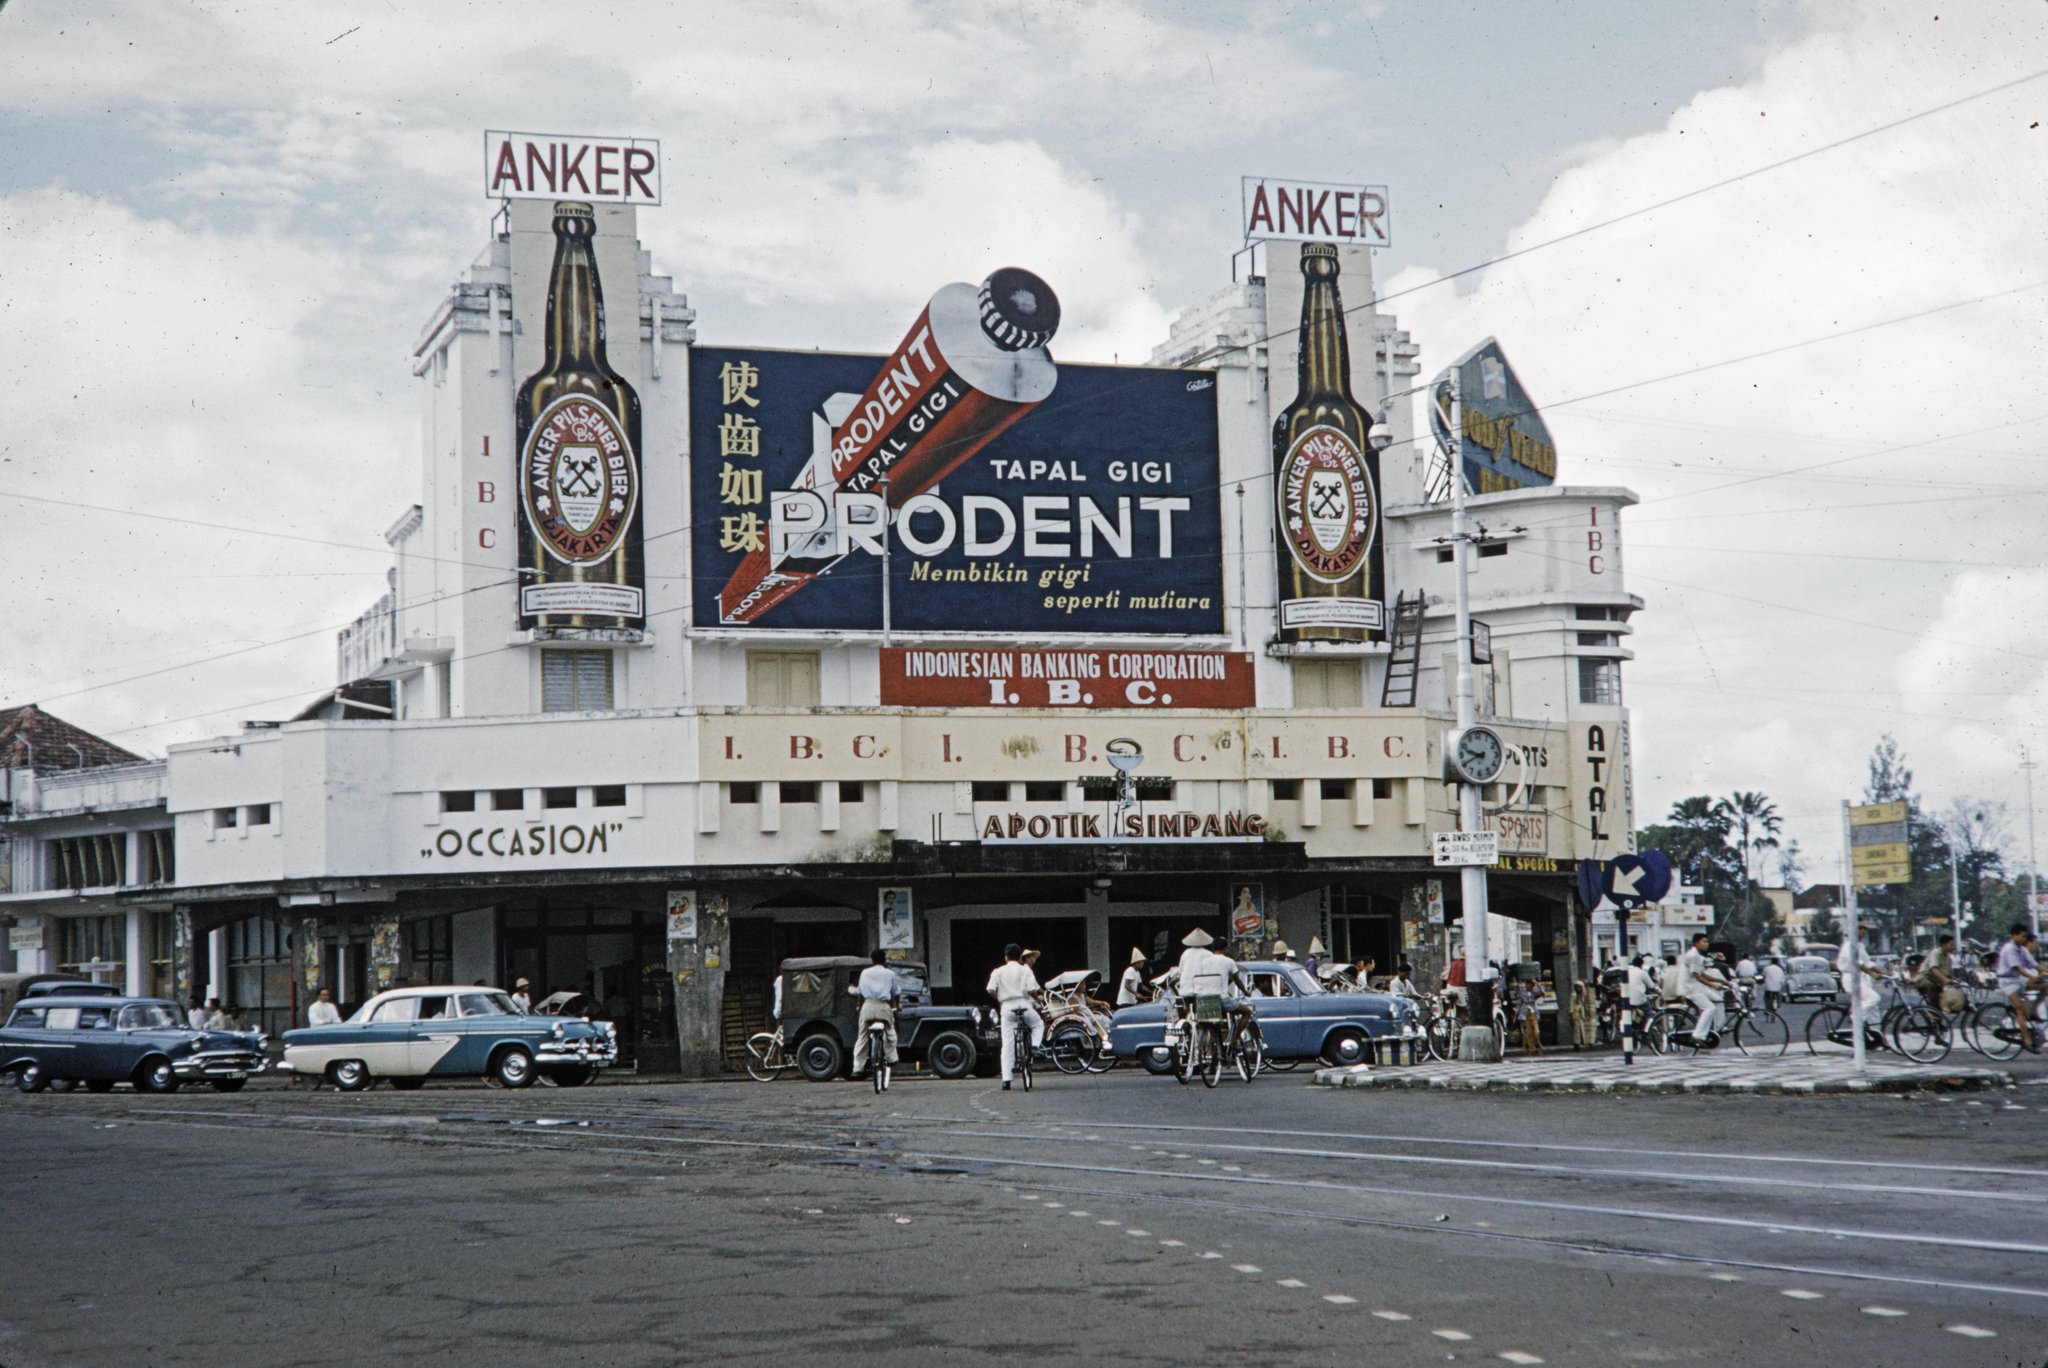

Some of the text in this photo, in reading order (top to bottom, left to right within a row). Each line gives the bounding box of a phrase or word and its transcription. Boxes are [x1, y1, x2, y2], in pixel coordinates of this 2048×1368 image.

[492, 140, 655, 198] ANKER
[1249, 185, 1386, 239] ANKER
[831, 324, 936, 472] PRODENT
[533, 405, 628, 495] ANKER PILSENER BIER
[718, 360, 766, 553] 使齒如珠
[848, 382, 960, 492] TAPAL GIGI
[990, 459, 1172, 483] TAPAL GIGI
[1287, 434, 1369, 517] ANKER PILSENER BIER
[542, 518, 618, 554] DJAKARTA
[770, 491, 1190, 558] PRODENT
[910, 561, 1090, 589] Membikin gigi
[1297, 540, 1362, 571] DJAKARTA
[1043, 590, 1210, 614] seperti mutiara
[904, 651, 1226, 680] INDONESIAN BANKING CORPORATION
[1587, 724, 1609, 841] ATAL
[982, 811, 1264, 839] APOTIK SIMPANG
[1499, 816, 1542, 840] SPORTS
[1516, 857, 1558, 872] SPORTS
